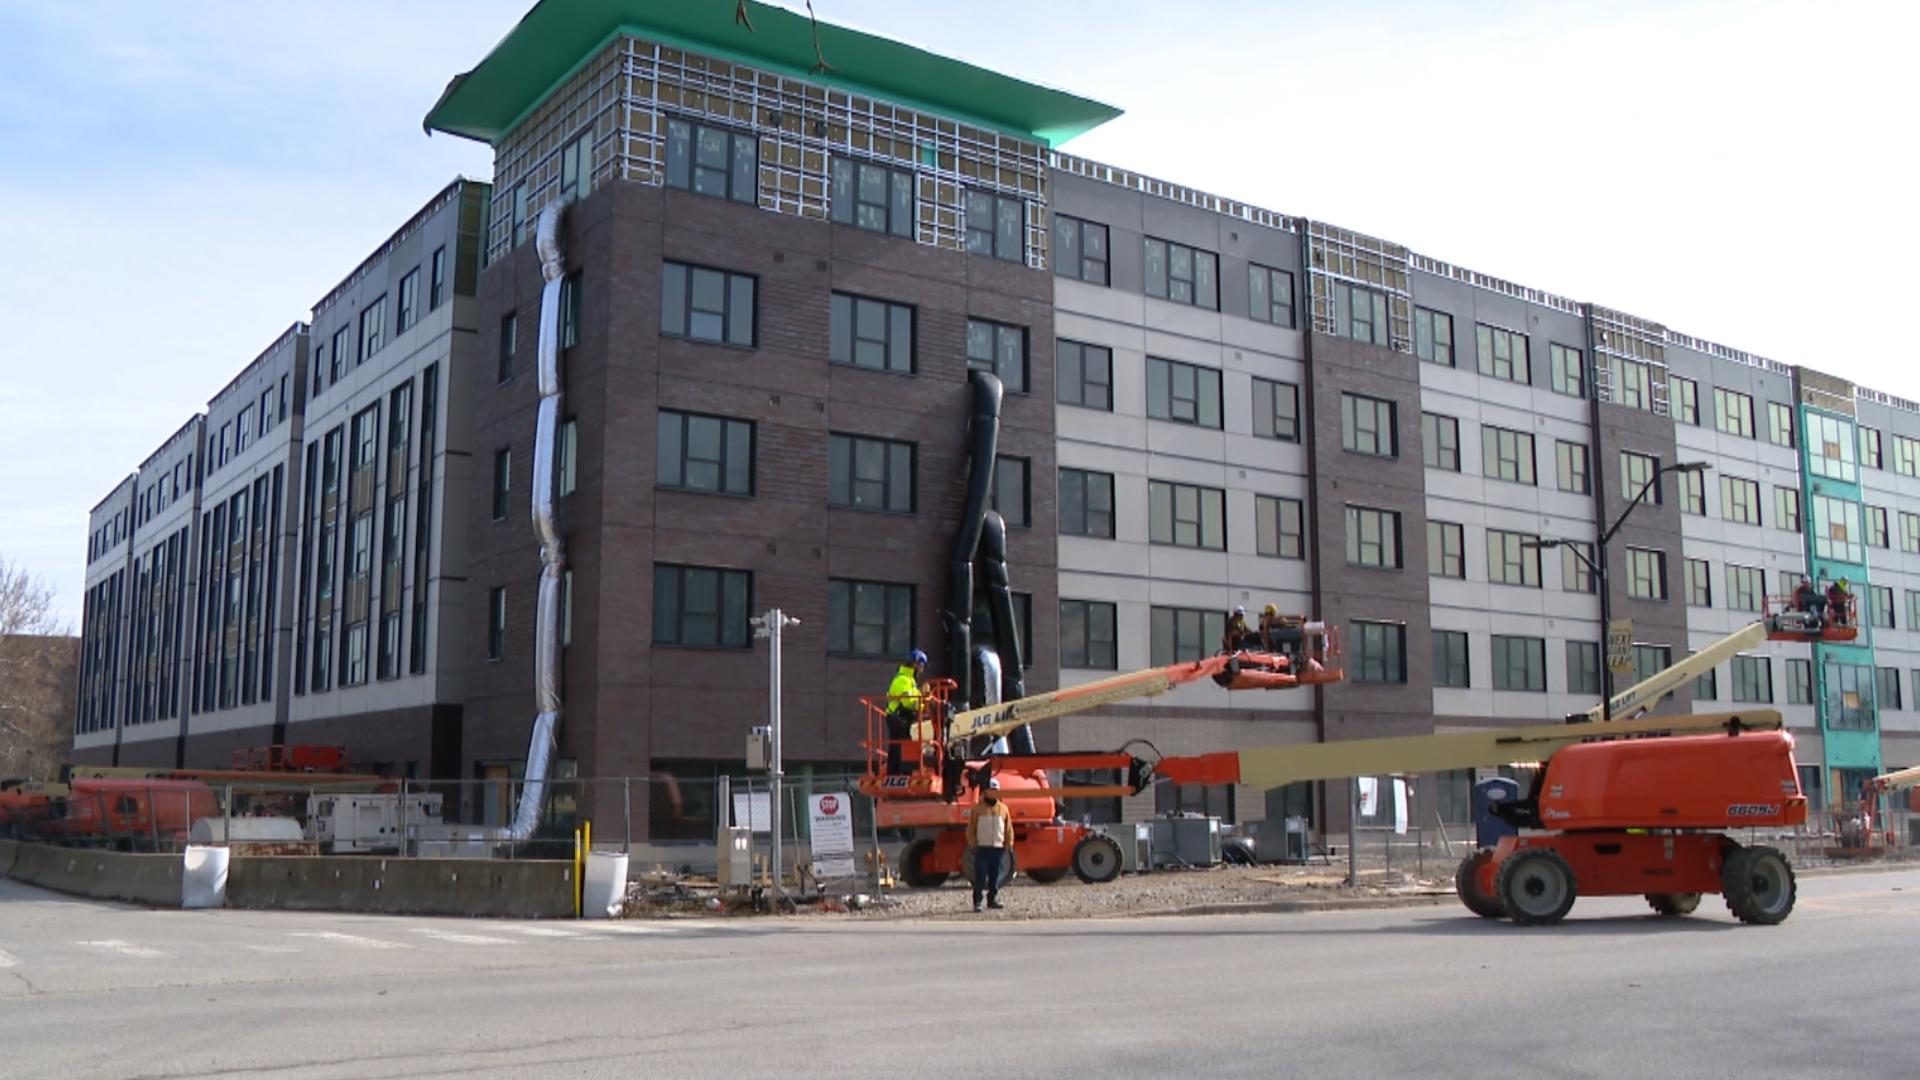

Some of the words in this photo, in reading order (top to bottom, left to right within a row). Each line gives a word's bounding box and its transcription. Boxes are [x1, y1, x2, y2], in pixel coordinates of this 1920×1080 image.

[1609, 633, 1631, 645] NEXT
[971, 714, 991, 729] JLG
[884, 776, 908, 788] JLG
[821, 799, 837, 810] STOP
